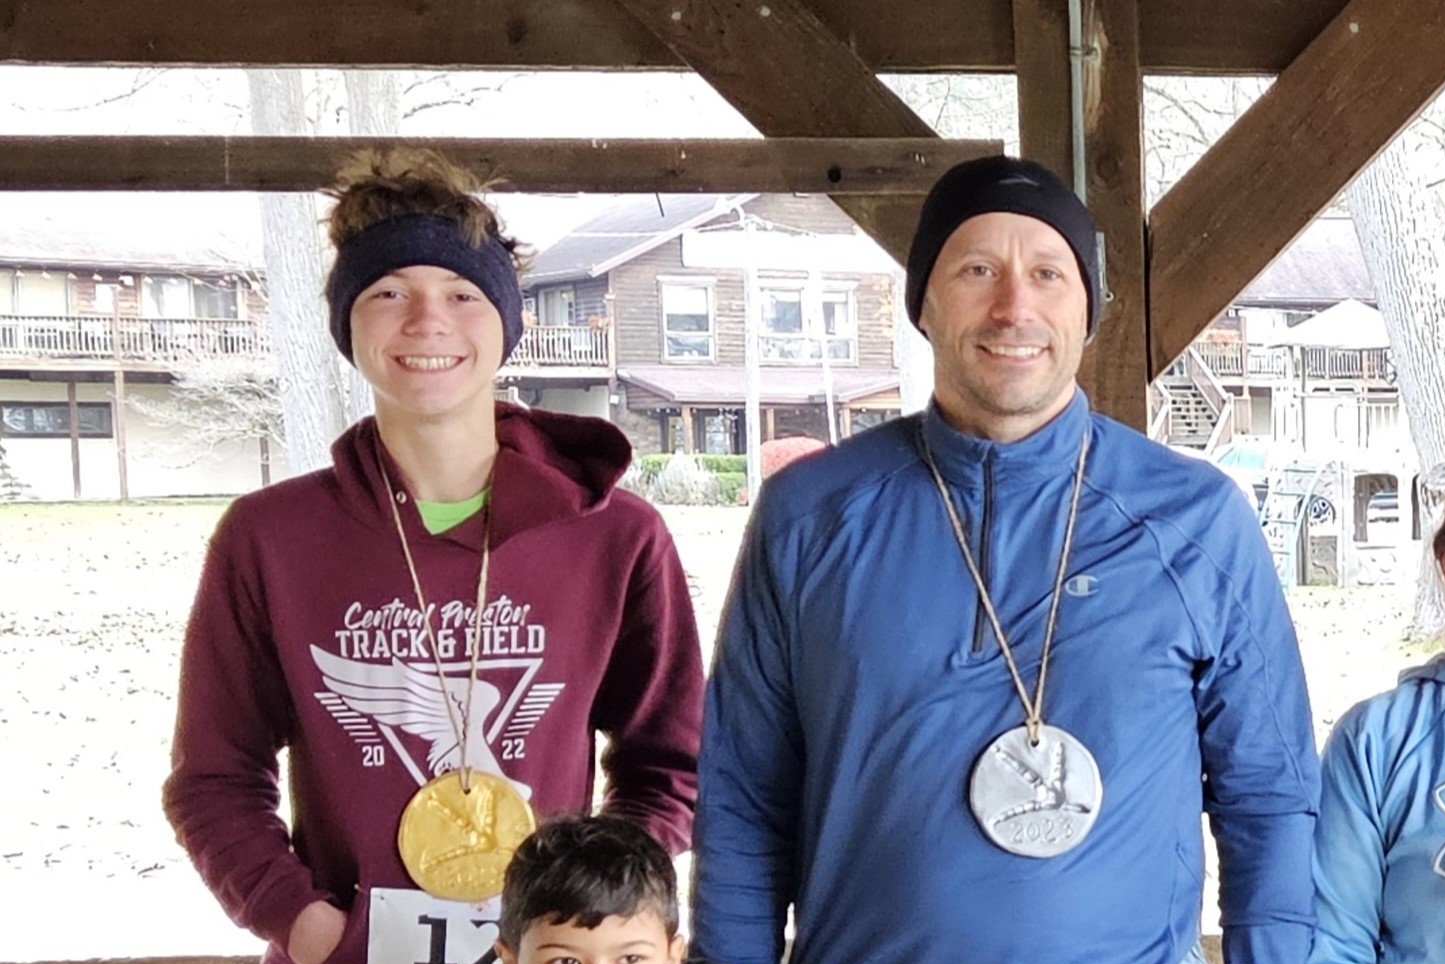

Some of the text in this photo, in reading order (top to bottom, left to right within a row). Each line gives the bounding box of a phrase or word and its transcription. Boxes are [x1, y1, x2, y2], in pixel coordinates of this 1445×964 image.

[344, 594, 531, 630] Central Preston
[335, 625, 545, 658] TRACK & FIELD
[362, 738, 525, 767] 20 22
